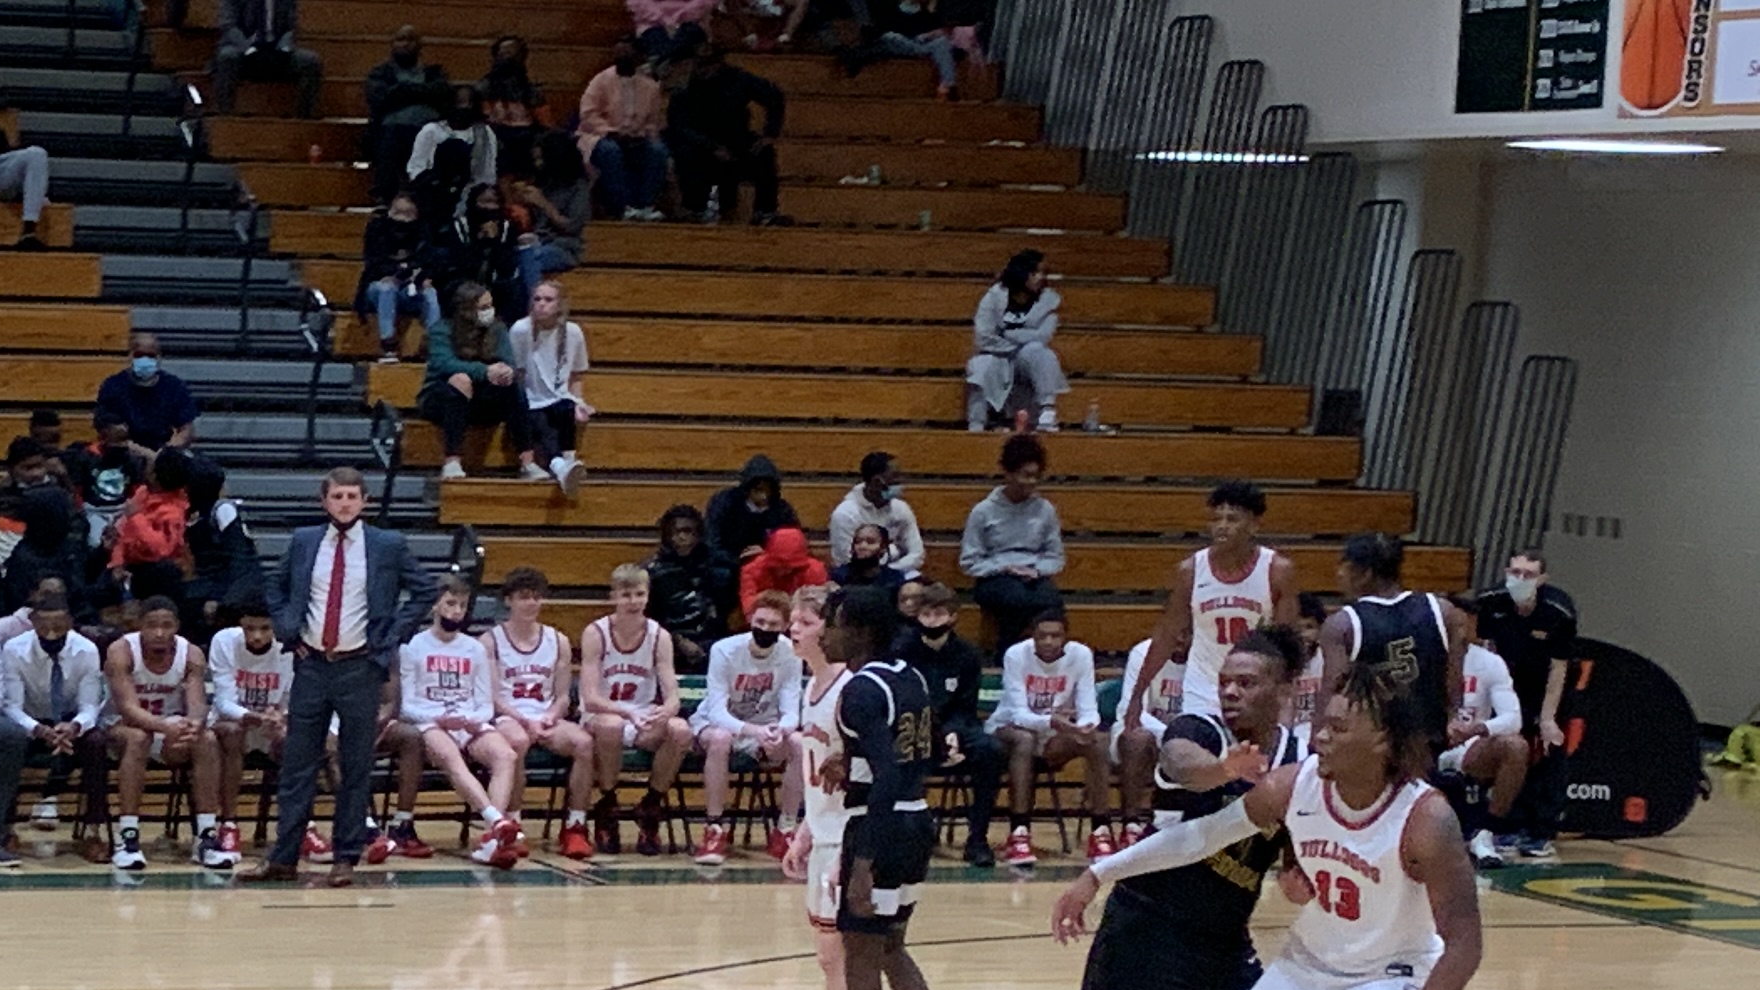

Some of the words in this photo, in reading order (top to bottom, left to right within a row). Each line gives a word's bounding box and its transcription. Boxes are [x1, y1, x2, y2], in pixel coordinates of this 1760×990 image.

[427, 655, 471, 674] JUST
[1389, 635, 1420, 684] 5
[895, 705, 933, 764] 24
[1566, 782, 1611, 801] com
[1315, 869, 1361, 922] 13
